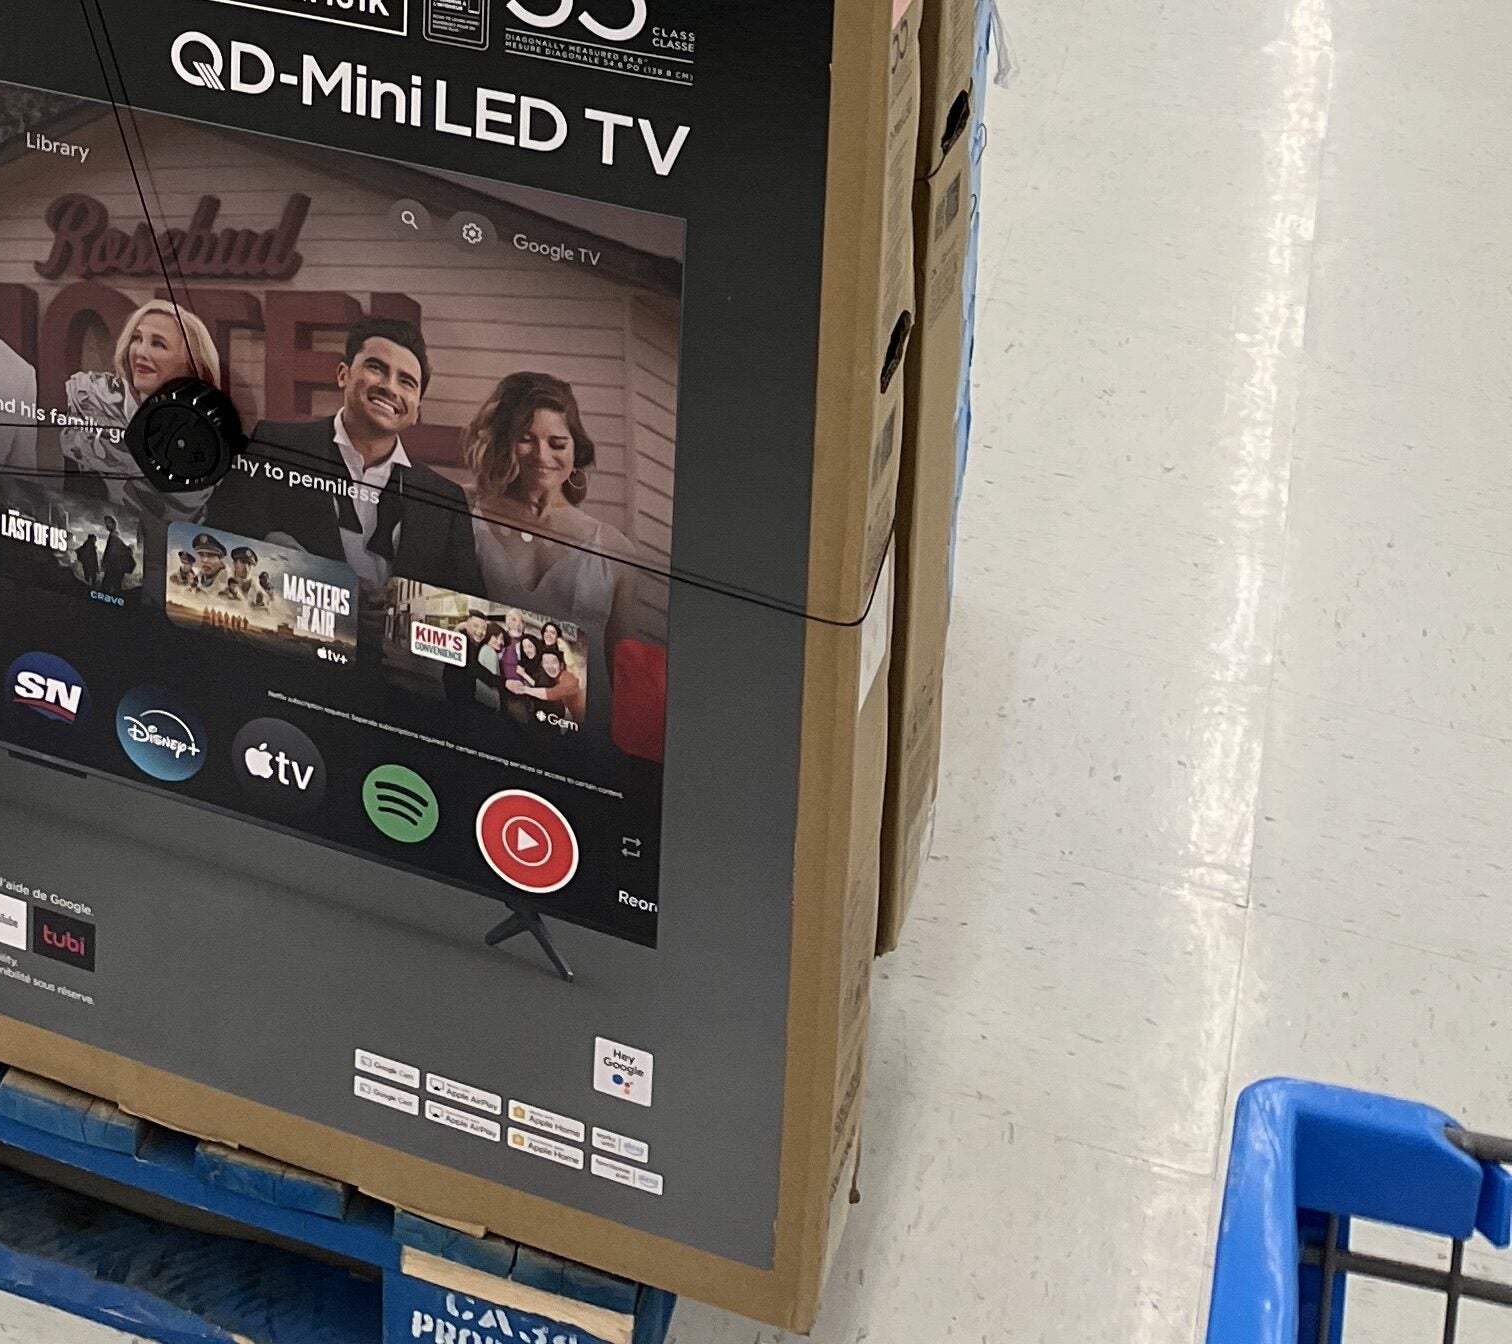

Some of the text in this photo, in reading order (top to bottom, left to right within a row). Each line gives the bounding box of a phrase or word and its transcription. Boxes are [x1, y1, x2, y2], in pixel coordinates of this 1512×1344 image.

[651, 25, 696, 43] CLASS
[26, 131, 91, 163] Library
[583, 108, 691, 177] TV
[19, 399, 47, 422] his
[49, 406, 104, 439] family
[263, 457, 382, 505] to penniless
[1, 513, 33, 544] LAST
[34, 526, 51, 549] OF
[52, 529, 68, 553] US
[282, 572, 352, 618] MASTERS
[413, 623, 464, 654] KIM'S
[13, 669, 84, 712] SN
[274, 751, 316, 793] tv
[42, 921, 86, 956] tubi
[602, 1056, 645, 1079] Google
[612, 1047, 636, 1066] Hey
